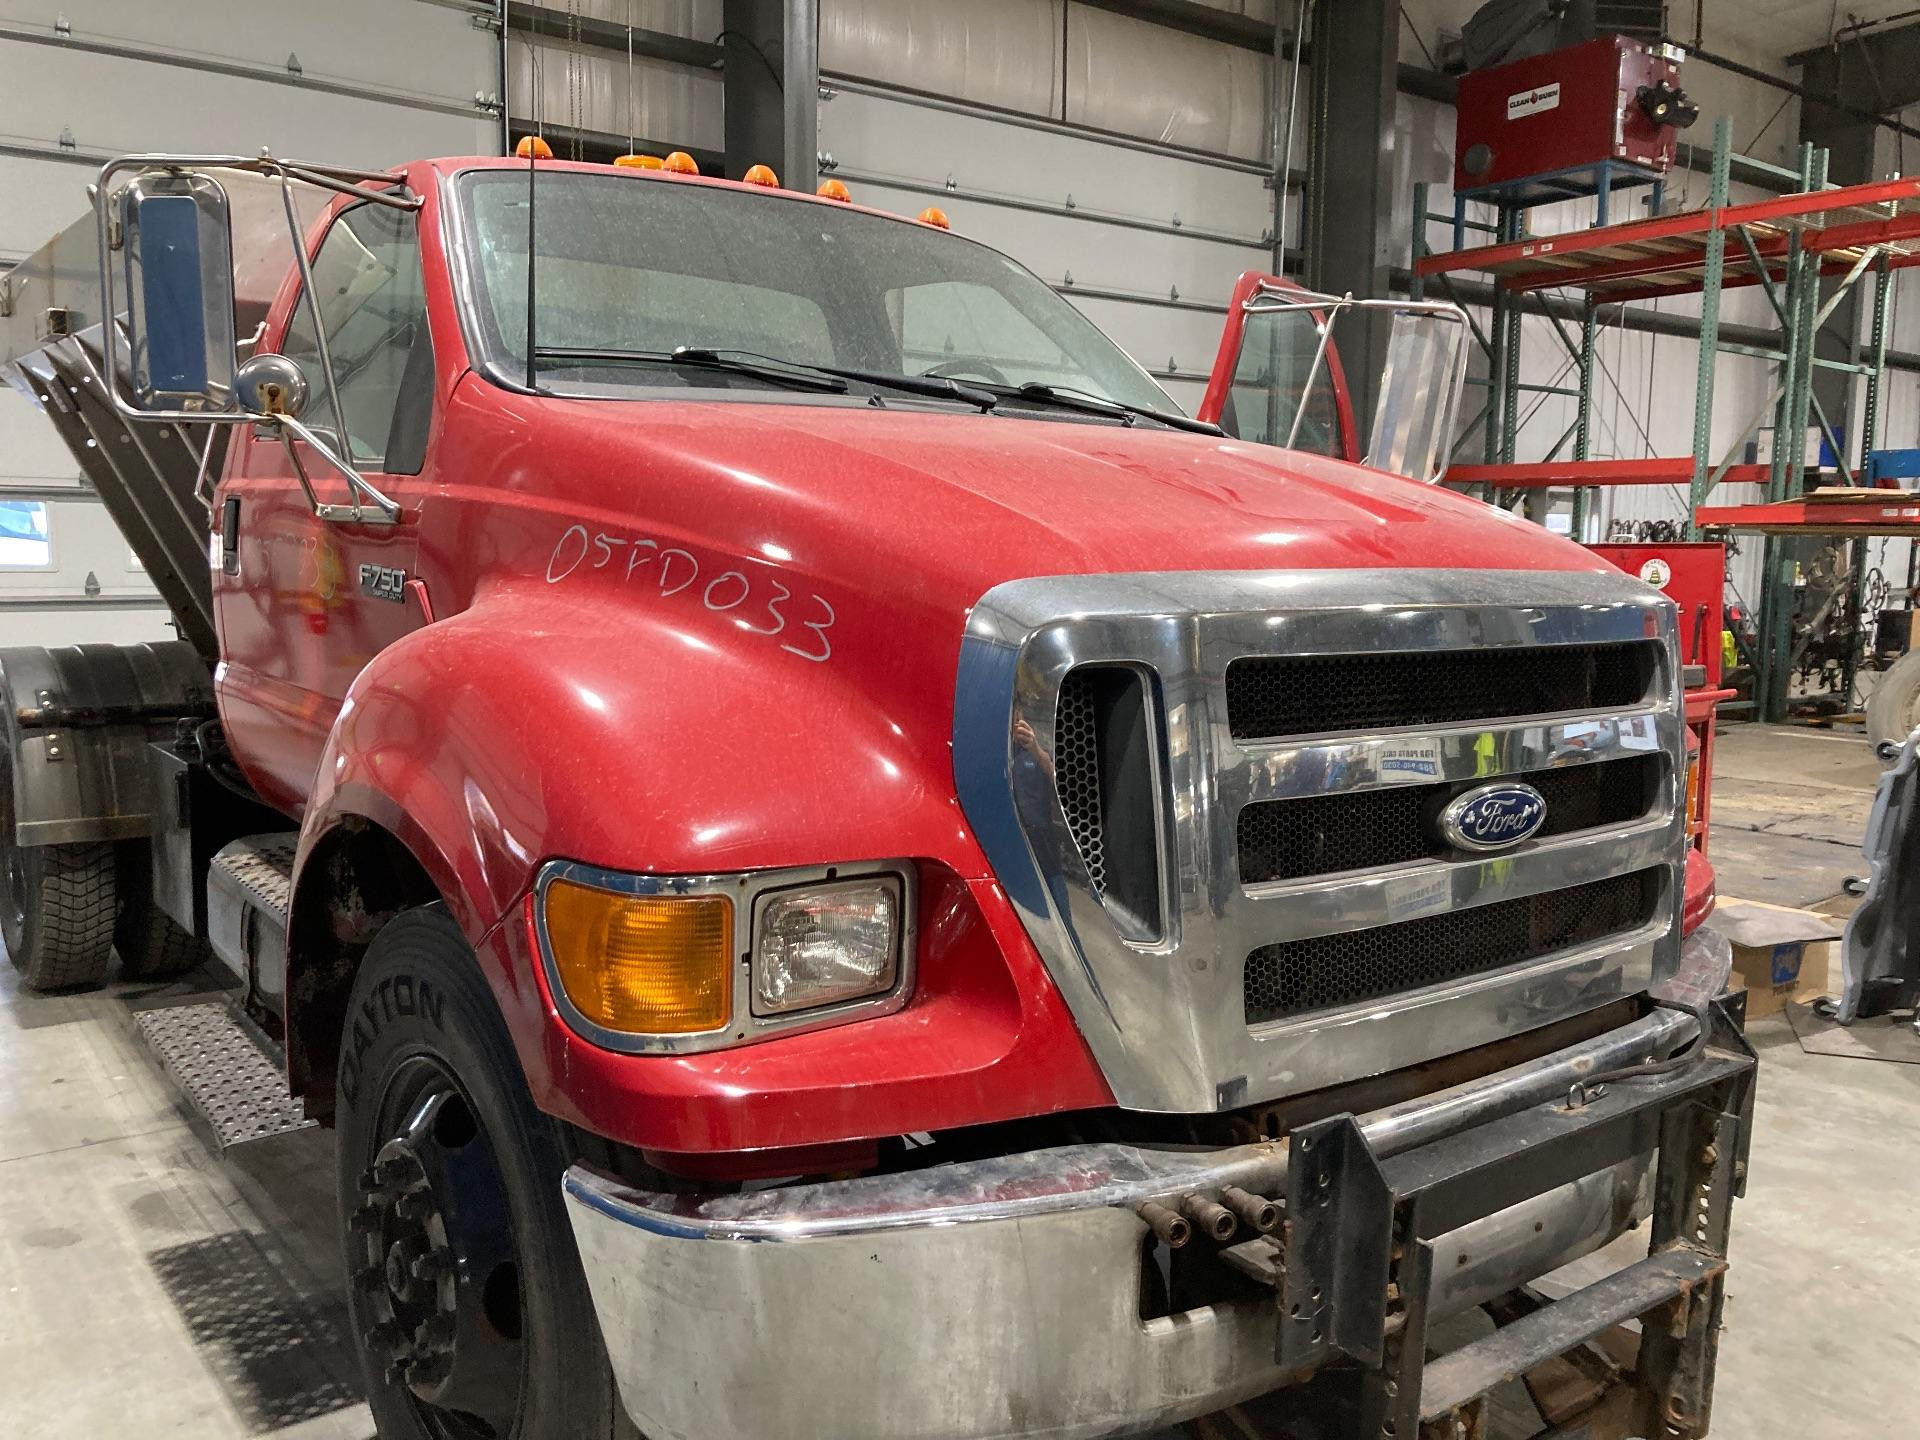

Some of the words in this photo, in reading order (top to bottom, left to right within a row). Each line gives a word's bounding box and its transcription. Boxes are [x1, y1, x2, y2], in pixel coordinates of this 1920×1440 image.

[1510, 98, 1529, 108] CLEAN
[1538, 90, 1558, 100] BURN
[359, 564, 405, 593] F750
[372, 589, 388, 599] SUPER
[388, 592, 402, 601] DUTY
[546, 524, 835, 662] 05FD033
[1475, 798, 1530, 836] Ford
[340, 975, 446, 1113] DAYTON
